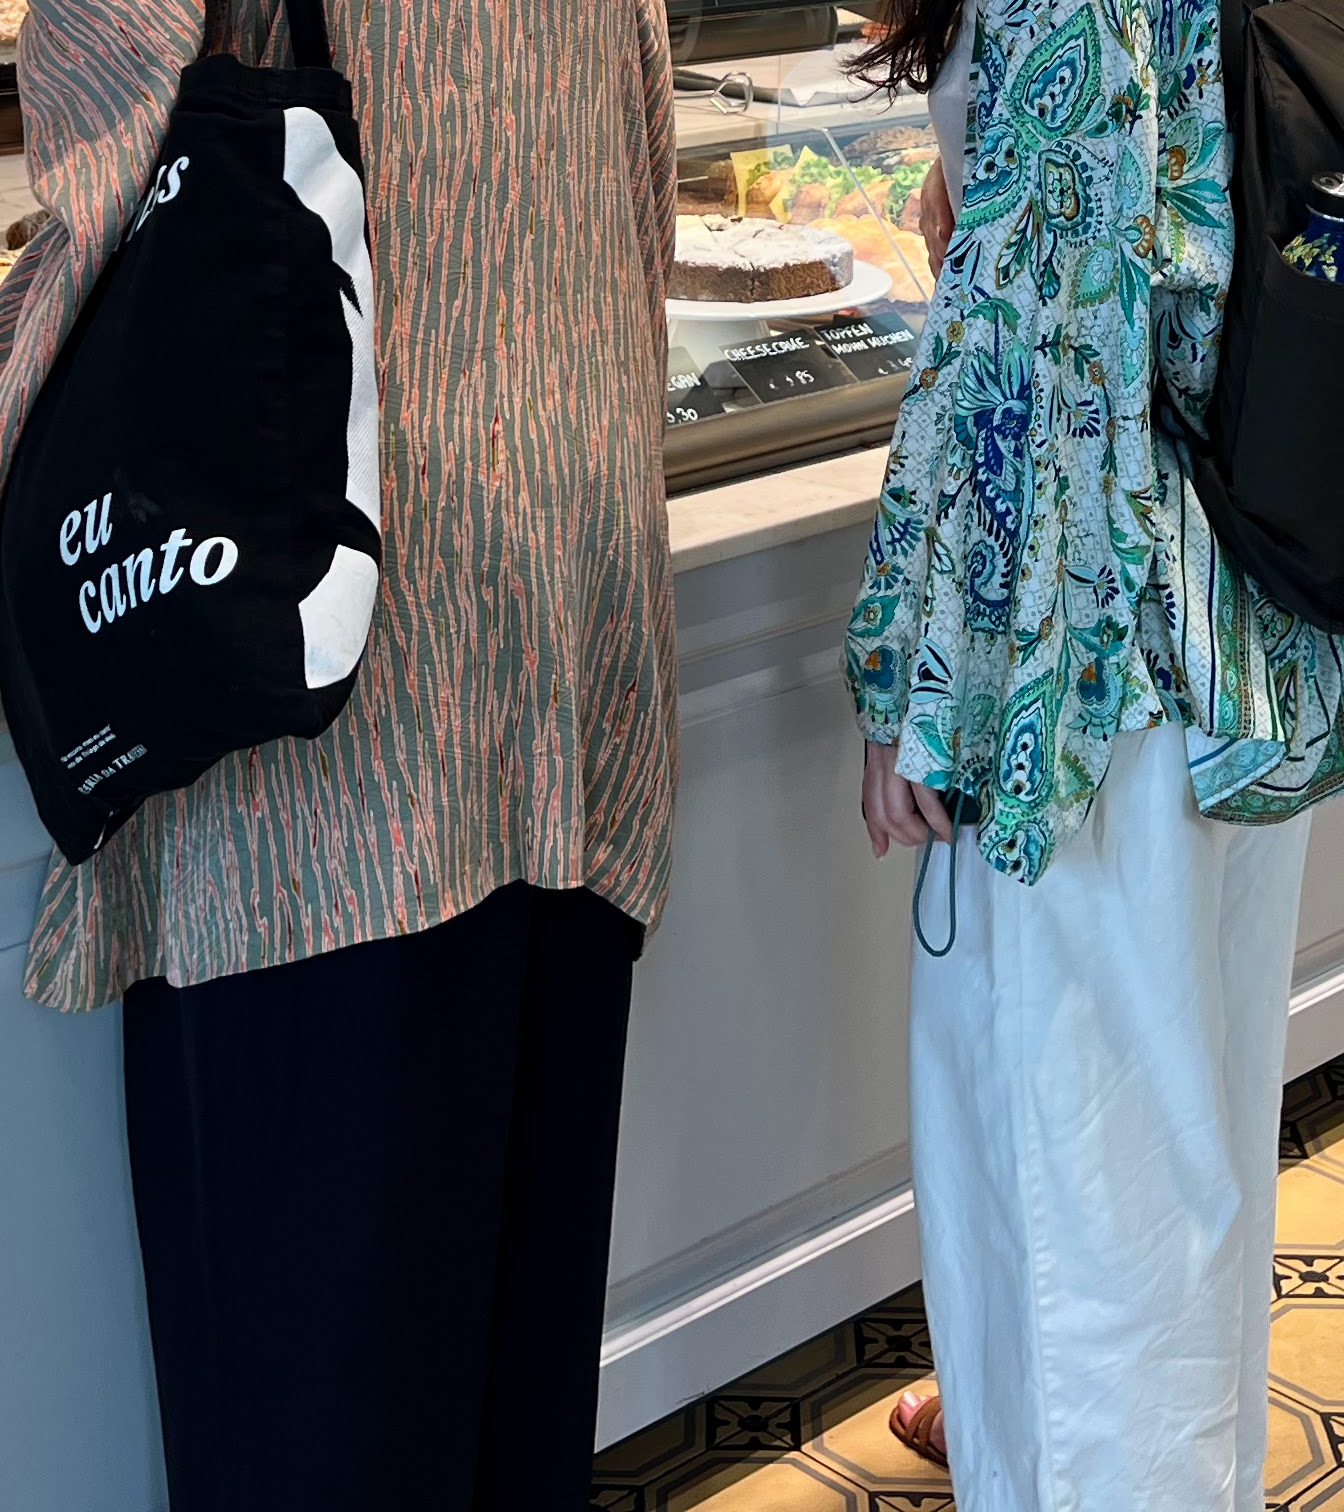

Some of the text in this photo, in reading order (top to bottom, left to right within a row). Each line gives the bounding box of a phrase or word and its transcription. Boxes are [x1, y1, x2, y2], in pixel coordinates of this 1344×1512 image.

[724, 337, 809, 362] CHEESECAKE
[820, 323, 873, 340] TOPFEN
[58, 492, 114, 567] eu
[78, 528, 238, 634] canto
